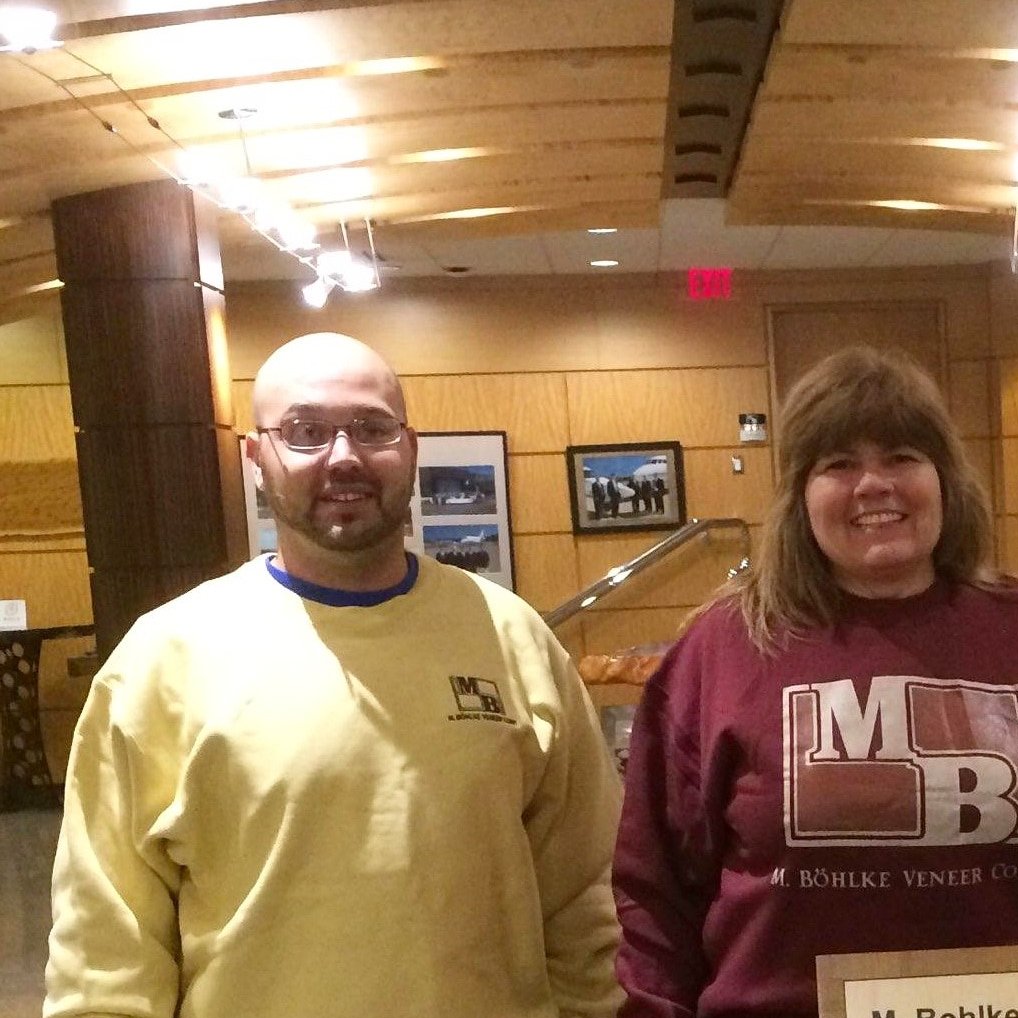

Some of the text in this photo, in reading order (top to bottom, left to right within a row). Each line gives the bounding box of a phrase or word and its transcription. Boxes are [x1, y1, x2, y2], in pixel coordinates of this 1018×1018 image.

[688, 267, 732, 300] EXIT
[770, 867, 790, 887] M.
[800, 868, 891, 888] BÖHLKE
[903, 867, 983, 887] VENEER
